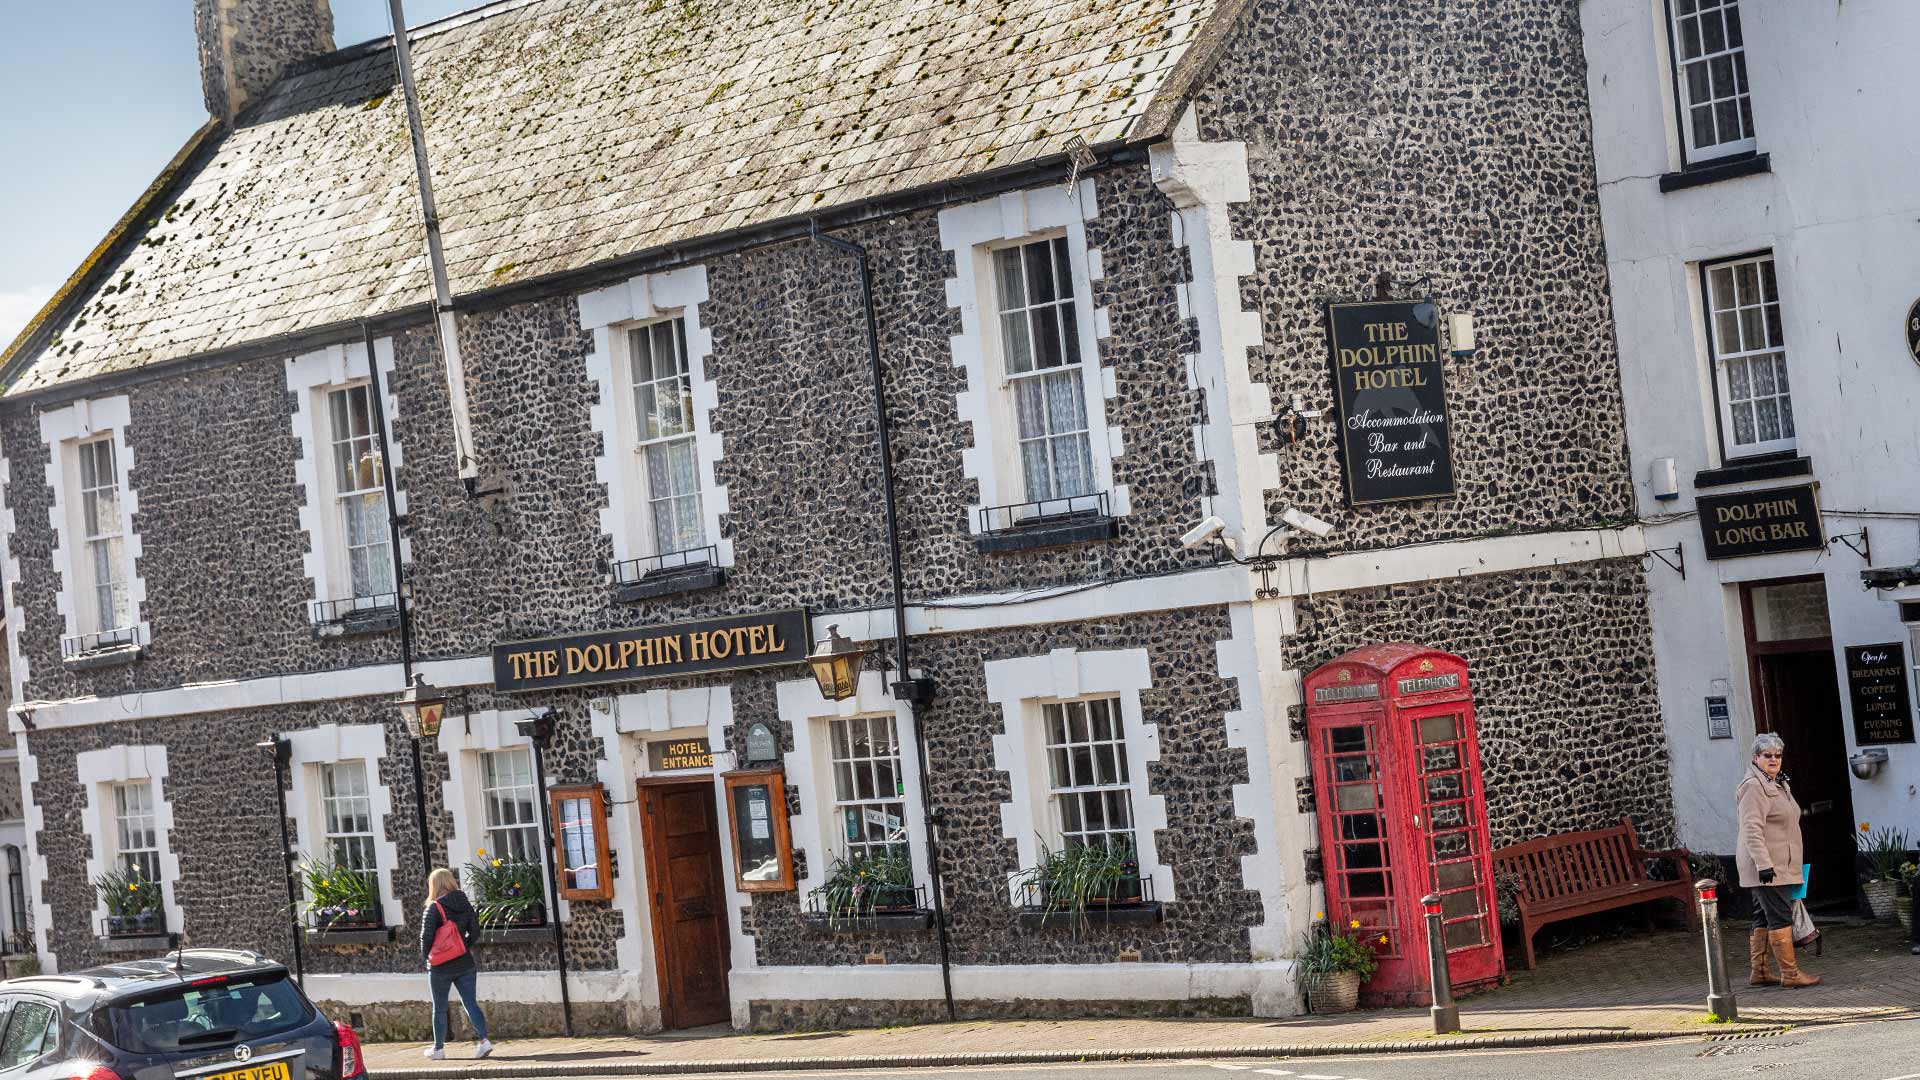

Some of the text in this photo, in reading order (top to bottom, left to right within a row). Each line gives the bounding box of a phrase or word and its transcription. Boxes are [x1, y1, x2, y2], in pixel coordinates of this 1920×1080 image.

[1364, 322, 1409, 343] THE
[1340, 343, 1438, 368] DOLPHIN
[1354, 367, 1428, 391] HOTEL
[1347, 407, 1445, 430] Accommodation
[1367, 432, 1427, 453] Bar and
[1366, 458, 1435, 479] Restaurant
[1717, 498, 1798, 524] DOLPHIN
[1715, 521, 1809, 546] LONG BAR
[508, 623, 785, 681] THE DOLPHIN HOTEL
[1861, 651, 1888, 664] Open for
[1399, 673, 1458, 693] TELEPHONE
[1852, 667, 1901, 679] BREAKFAST
[1861, 684, 1897, 695] COFFEE
[1866, 701, 1896, 712] LUNCH
[1864, 718, 1903, 729] EVENING
[1869, 729, 1900, 740] MEALS
[669, 742, 704, 755] HOTEL
[663, 754, 713, 769] ENTRANCE
